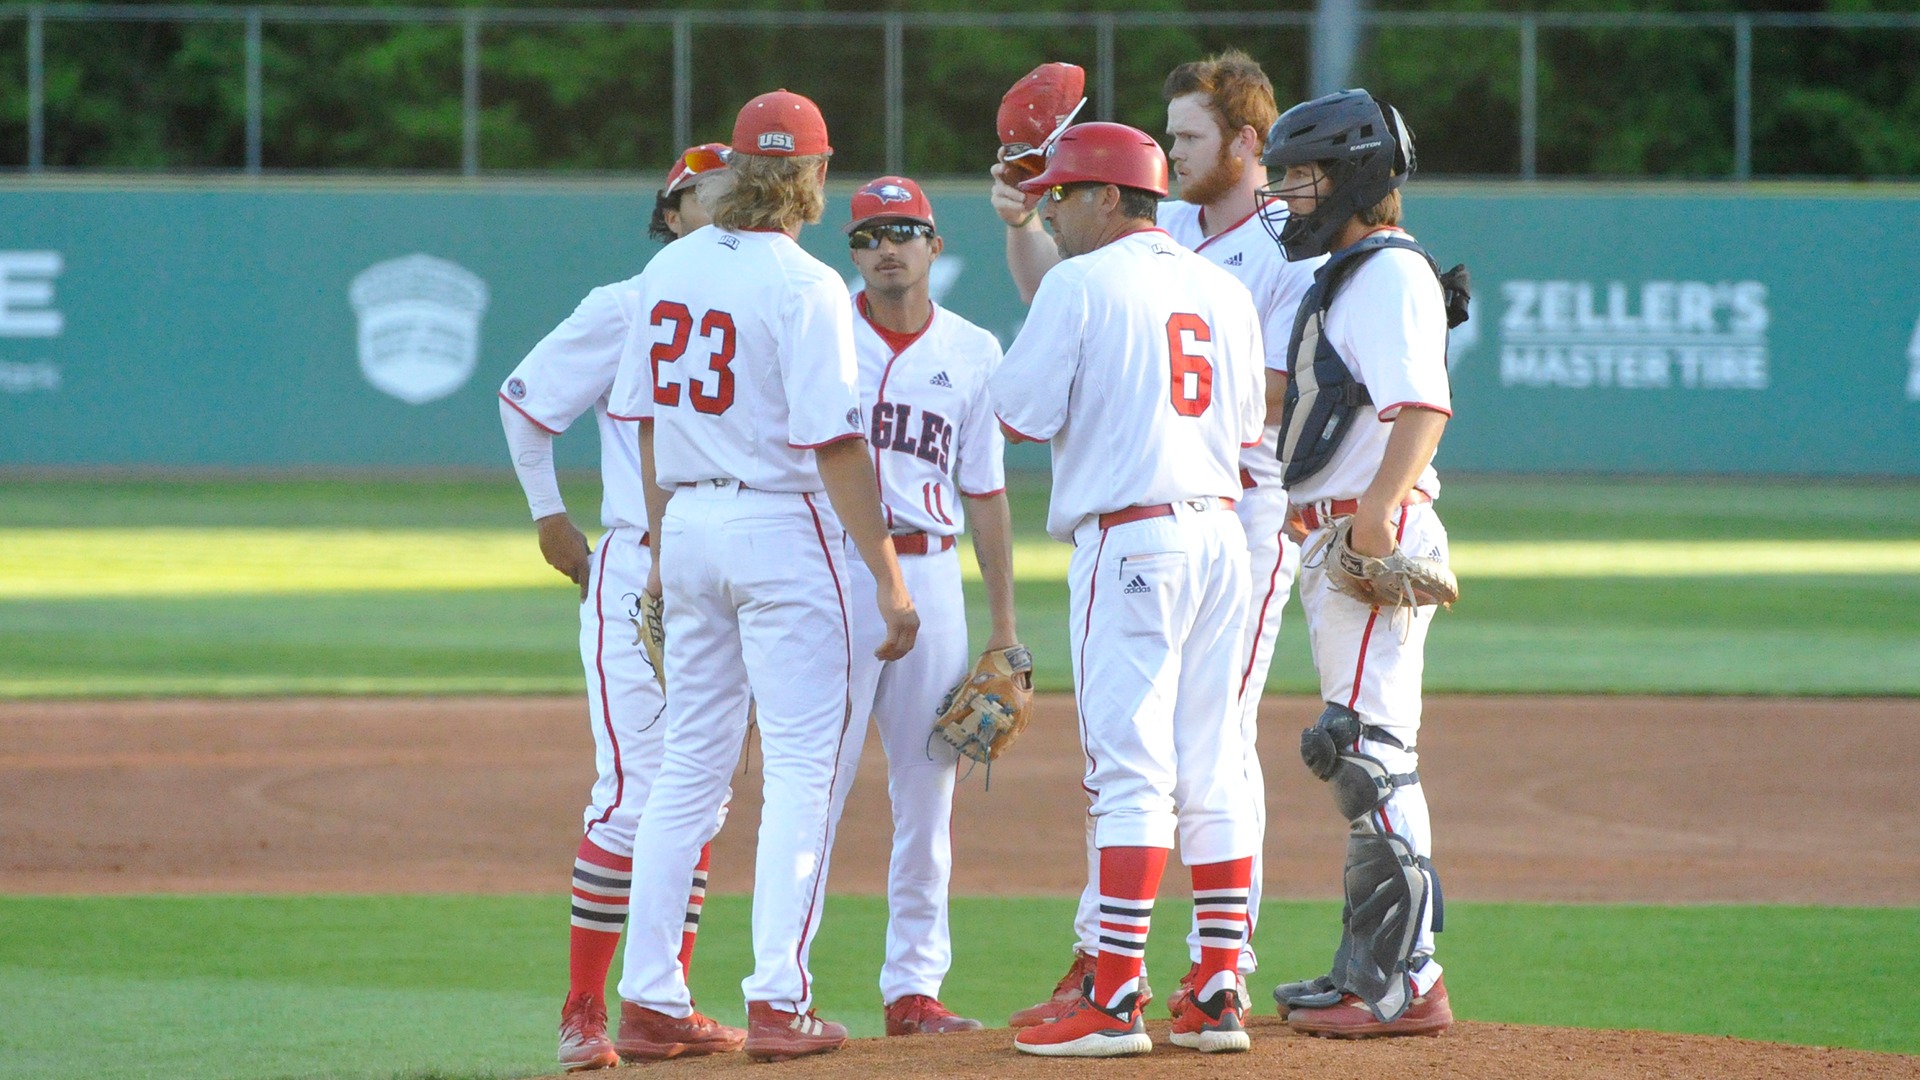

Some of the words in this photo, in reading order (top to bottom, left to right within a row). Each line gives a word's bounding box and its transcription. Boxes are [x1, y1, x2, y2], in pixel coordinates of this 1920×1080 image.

[759, 132, 794, 150] USI
[1350, 141, 1382, 151] EASTON
[1502, 281, 1770, 331] ZELLER'S
[650, 300, 736, 416] 23
[1166, 312, 1213, 417] 6
[1502, 345, 1670, 388] MASTER
[1675, 346, 1770, 388] TIRE
[866, 402, 953, 475] GLES
[922, 482, 954, 526] 11
[1123, 586, 1151, 595] adidas
